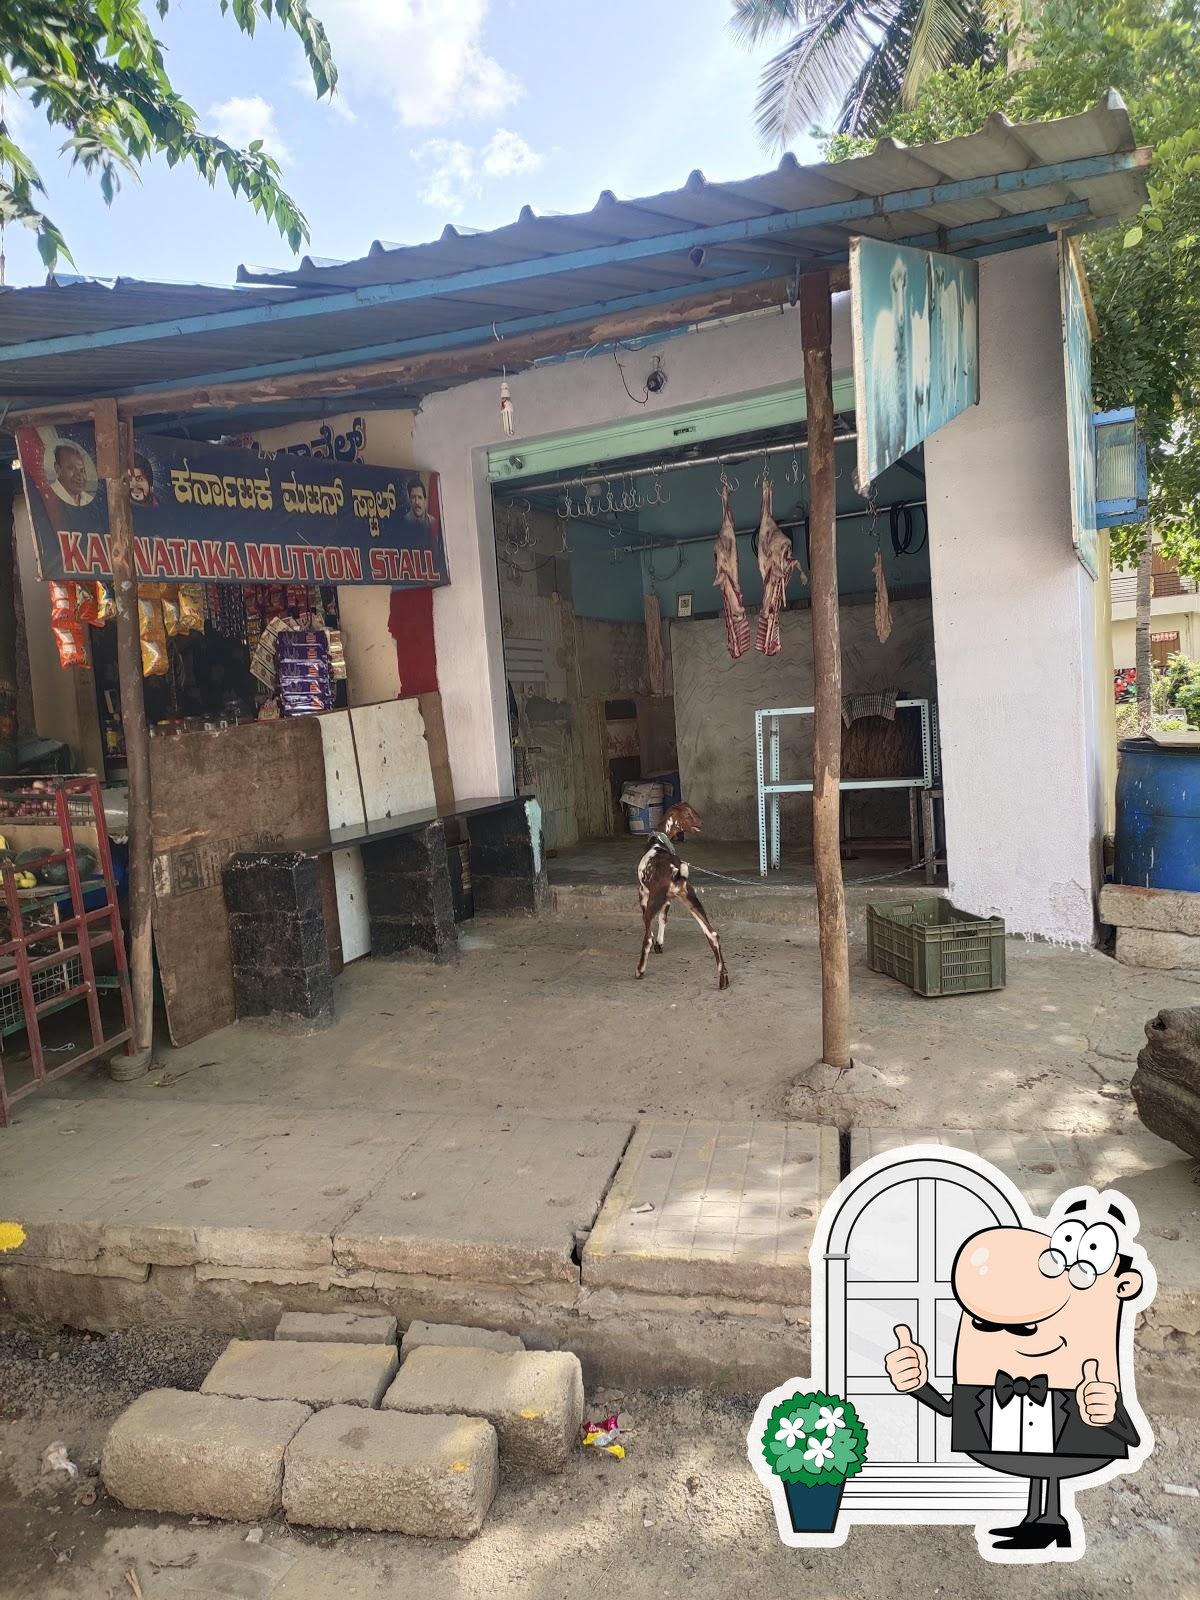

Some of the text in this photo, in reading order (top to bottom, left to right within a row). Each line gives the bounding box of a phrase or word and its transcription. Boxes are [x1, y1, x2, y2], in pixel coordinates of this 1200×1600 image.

[170, 457, 397, 537] ಕರ್ನಾಟಕ ಮಟನ್ ಸ್ಟಾಲ್
[57, 531, 440, 582] KANATAKA MUTTON STALL
